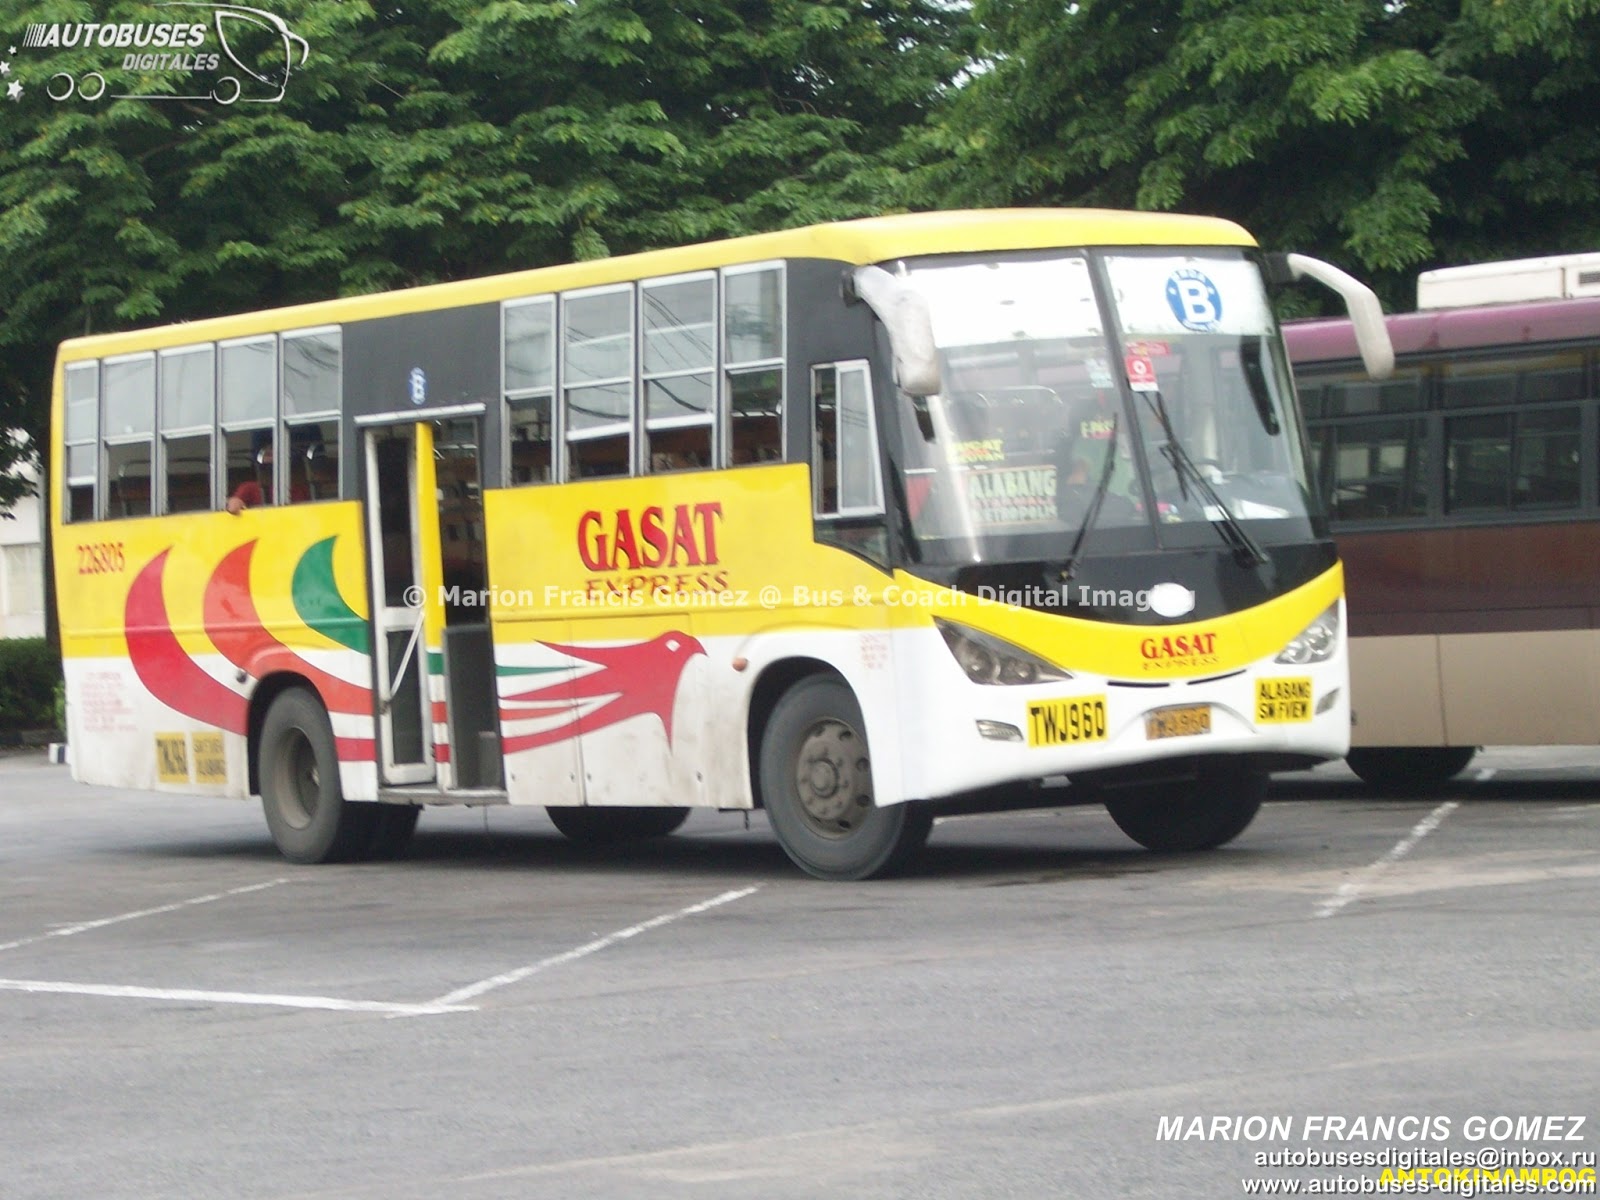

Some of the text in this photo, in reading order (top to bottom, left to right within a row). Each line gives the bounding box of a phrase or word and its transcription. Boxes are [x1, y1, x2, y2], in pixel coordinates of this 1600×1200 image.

[1177, 278, 1216, 324] B
[577, 501, 723, 572] GASAT
[584, 570, 730, 600] EXPRESS
[1140, 633, 1217, 660] GASAT
[1030, 701, 1105, 745] TWJ960
